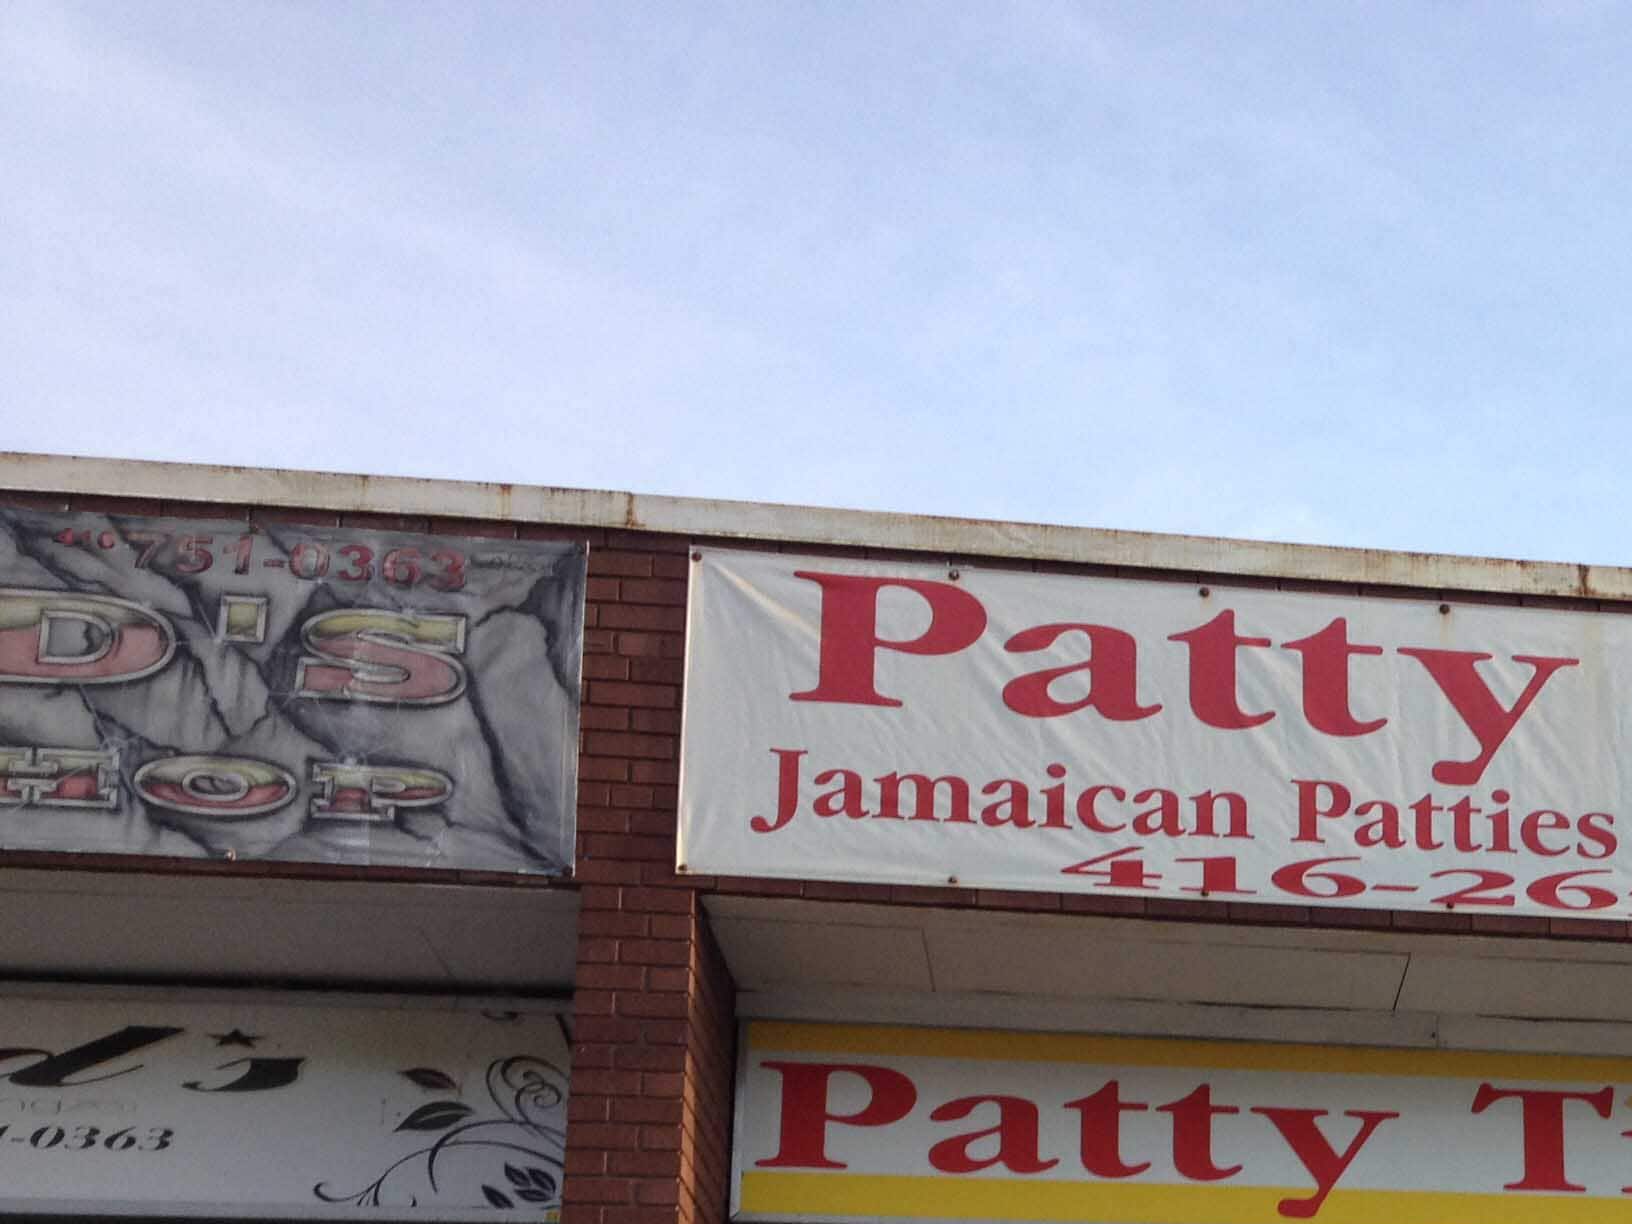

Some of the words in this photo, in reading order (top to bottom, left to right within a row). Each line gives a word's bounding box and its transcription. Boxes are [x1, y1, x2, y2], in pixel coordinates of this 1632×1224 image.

[124, 531, 467, 592] 751-0363
[789, 569, 1580, 786] Patty
[751, 747, 1255, 841] Jamaican
[1291, 778, 1618, 859] Patties
[754, 1060, 1400, 1219] Patty
